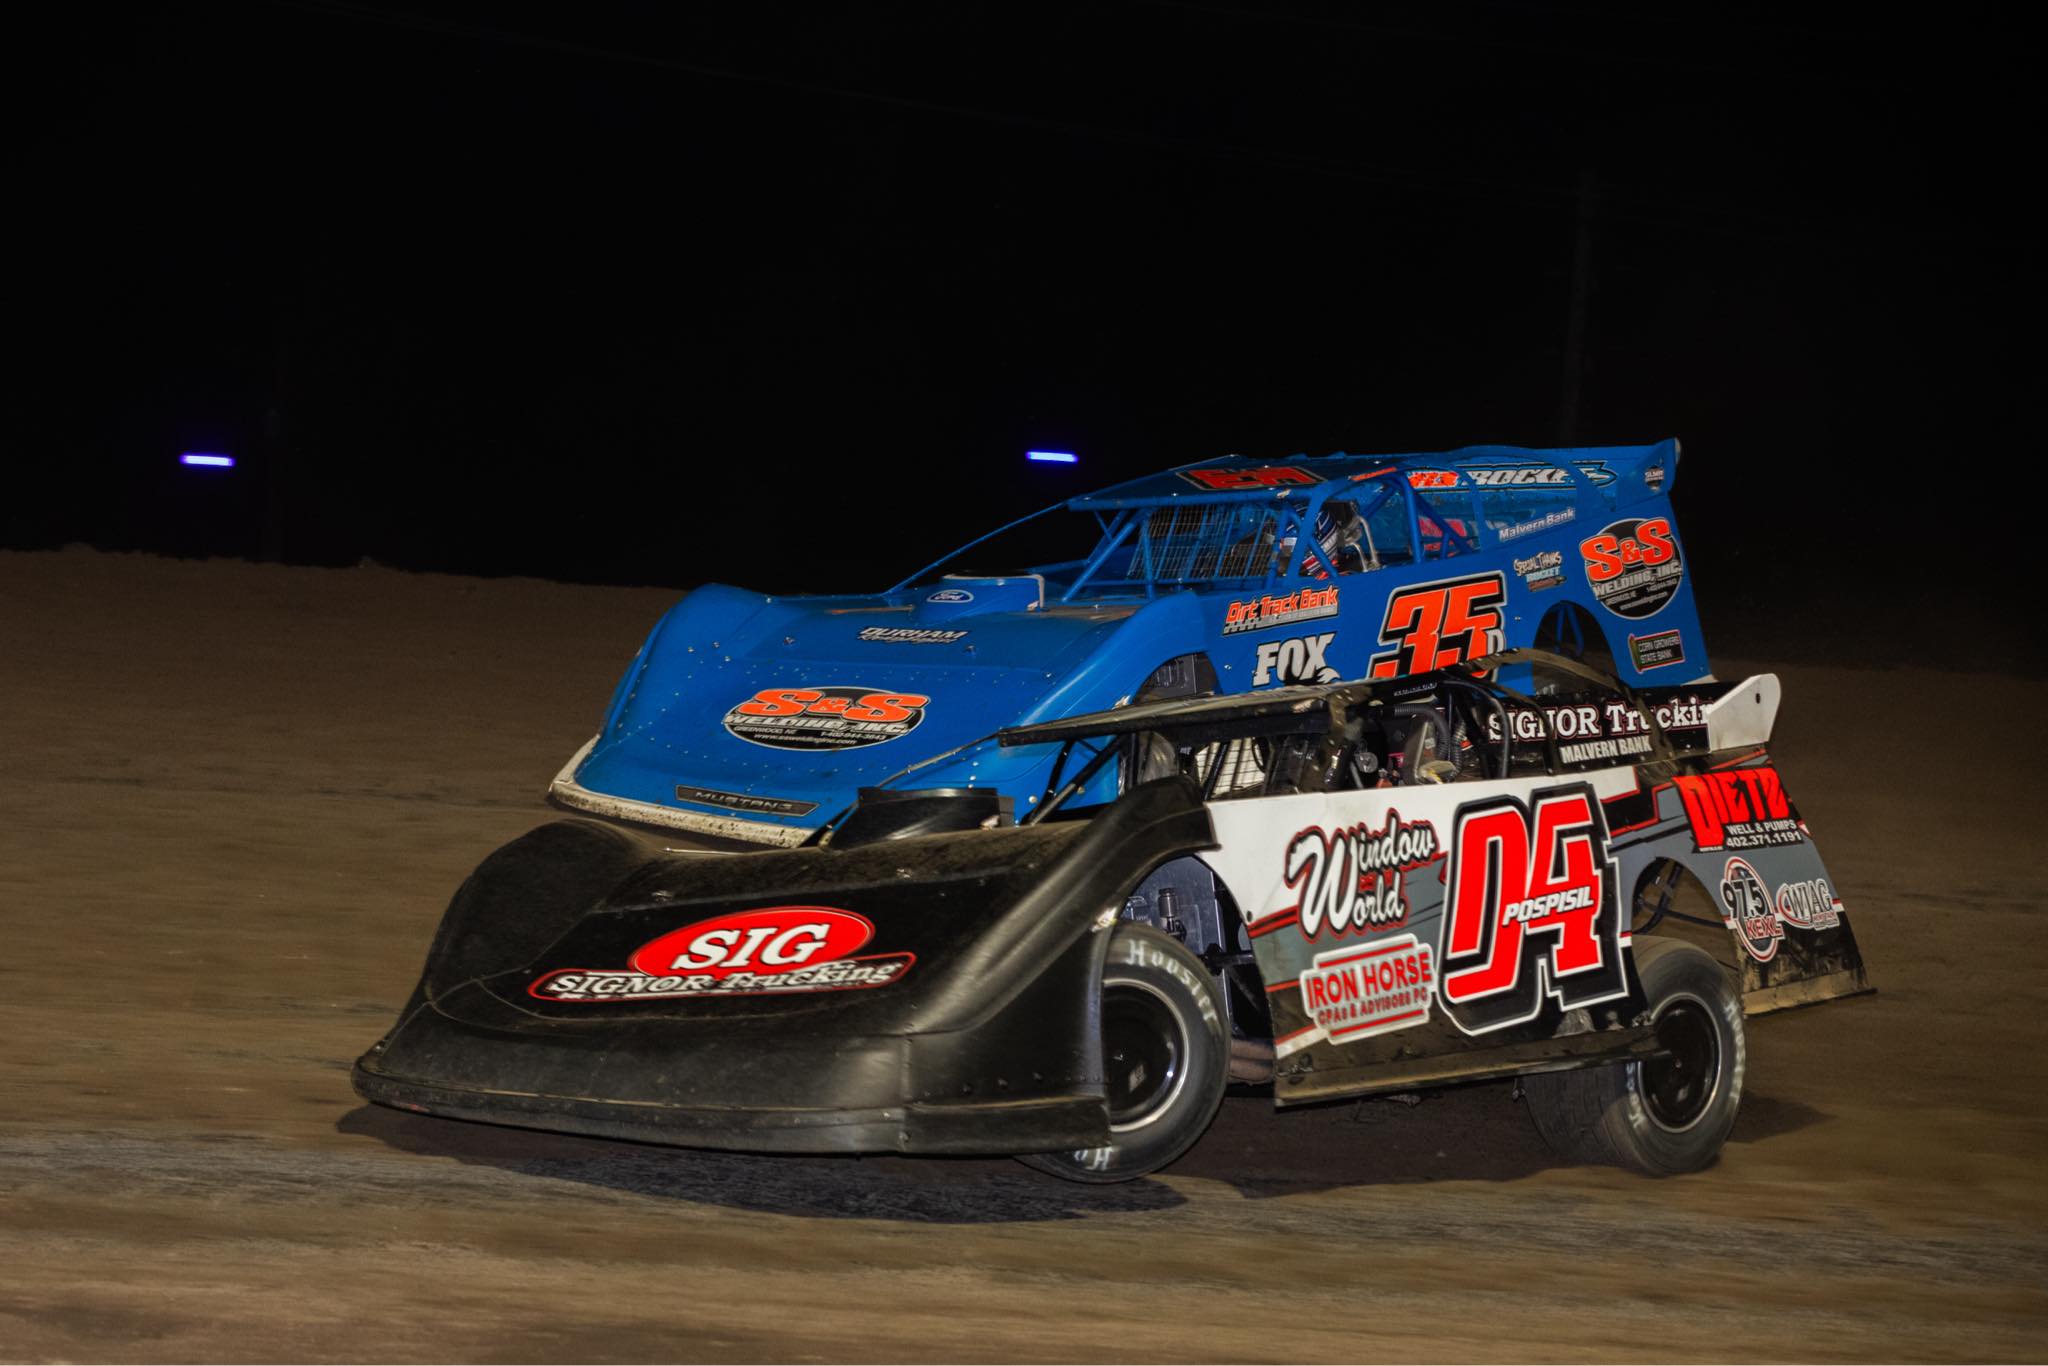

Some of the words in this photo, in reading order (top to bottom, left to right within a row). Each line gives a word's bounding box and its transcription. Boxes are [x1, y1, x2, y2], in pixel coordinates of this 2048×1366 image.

[1499, 517, 1545, 542] Malvern
[1546, 507, 1575, 528] Bank
[1580, 517, 1674, 582] S&S
[1225, 598, 1259, 623] Dirt
[1260, 592, 1300, 617] Track
[1300, 585, 1339, 610] Bank
[1373, 579, 1500, 679] 35
[1252, 632, 1336, 688] FOX
[737, 688, 931, 722] S&S
[1560, 739, 1618, 765] MALVERN
[1619, 734, 1653, 756] BANK
[695, 791, 793, 810] MUSTANG
[1672, 768, 1790, 848] DIETZ
[1726, 821, 1755, 836] WELL
[1755, 821, 1763, 834] &
[1764, 819, 1798, 834] PUMPS
[1726, 830, 1803, 849] 402.371.1191
[1443, 788, 1609, 1012] 04
[1502, 886, 1595, 926] POSPISIL
[1721, 878, 1767, 919] 97.5
[1744, 915, 1785, 939] KEXL
[670, 923, 832, 971] SIG
[547, 974, 711, 996] SIGNOR
[718, 960, 904, 990] Trucking
[1306, 969, 1358, 1009] IRON
[1363, 952, 1433, 996] HORSE
[1349, 1003, 1358, 1019] &
[1360, 991, 1411, 1016] ADVISORS
